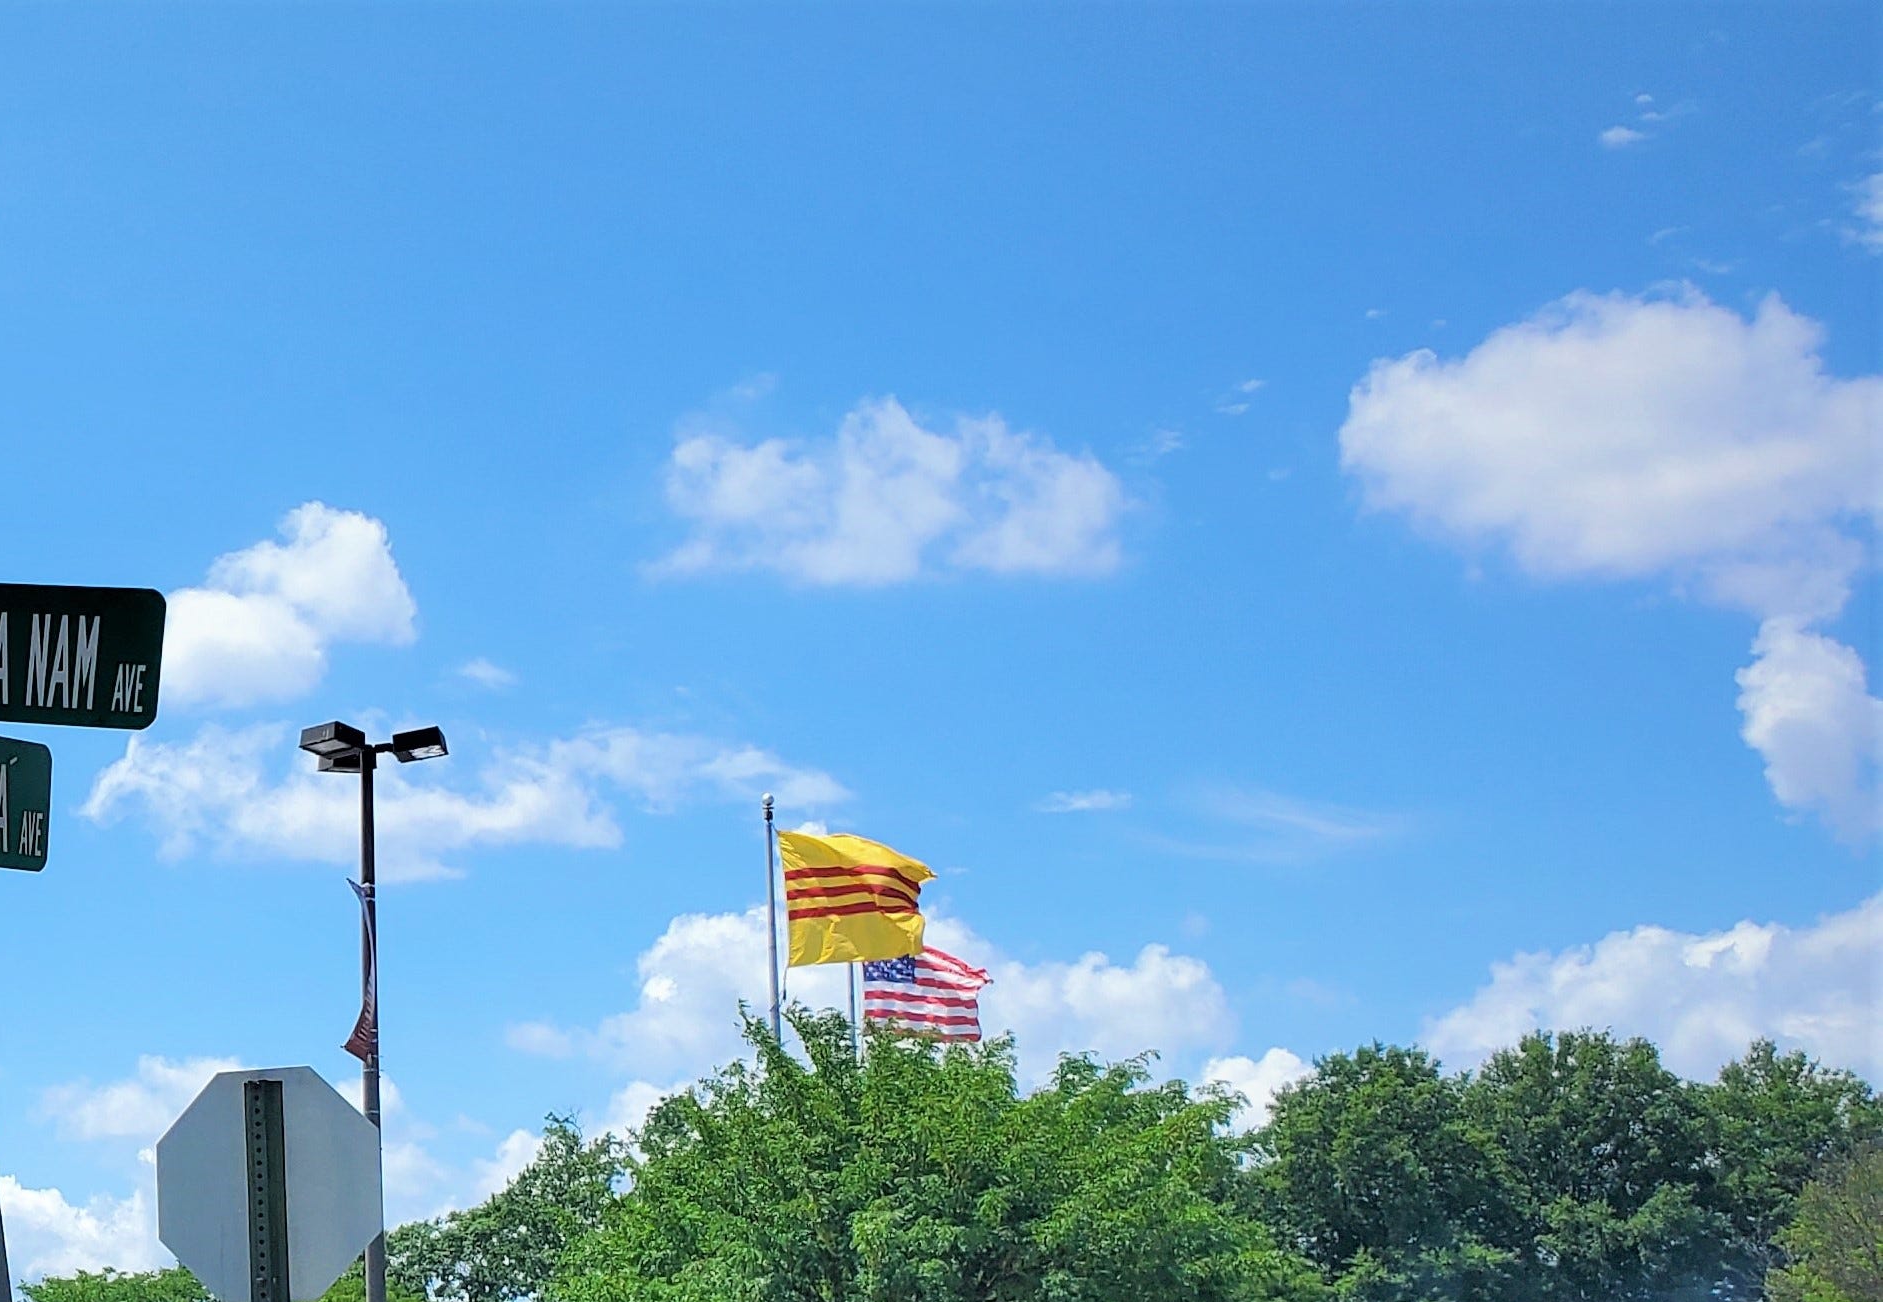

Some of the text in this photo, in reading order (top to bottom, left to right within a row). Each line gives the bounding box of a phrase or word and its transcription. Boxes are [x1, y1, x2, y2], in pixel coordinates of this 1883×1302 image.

[25, 613, 101, 710] NAM
[111, 664, 147, 713] AVE
[18, 810, 44, 857] AVE
